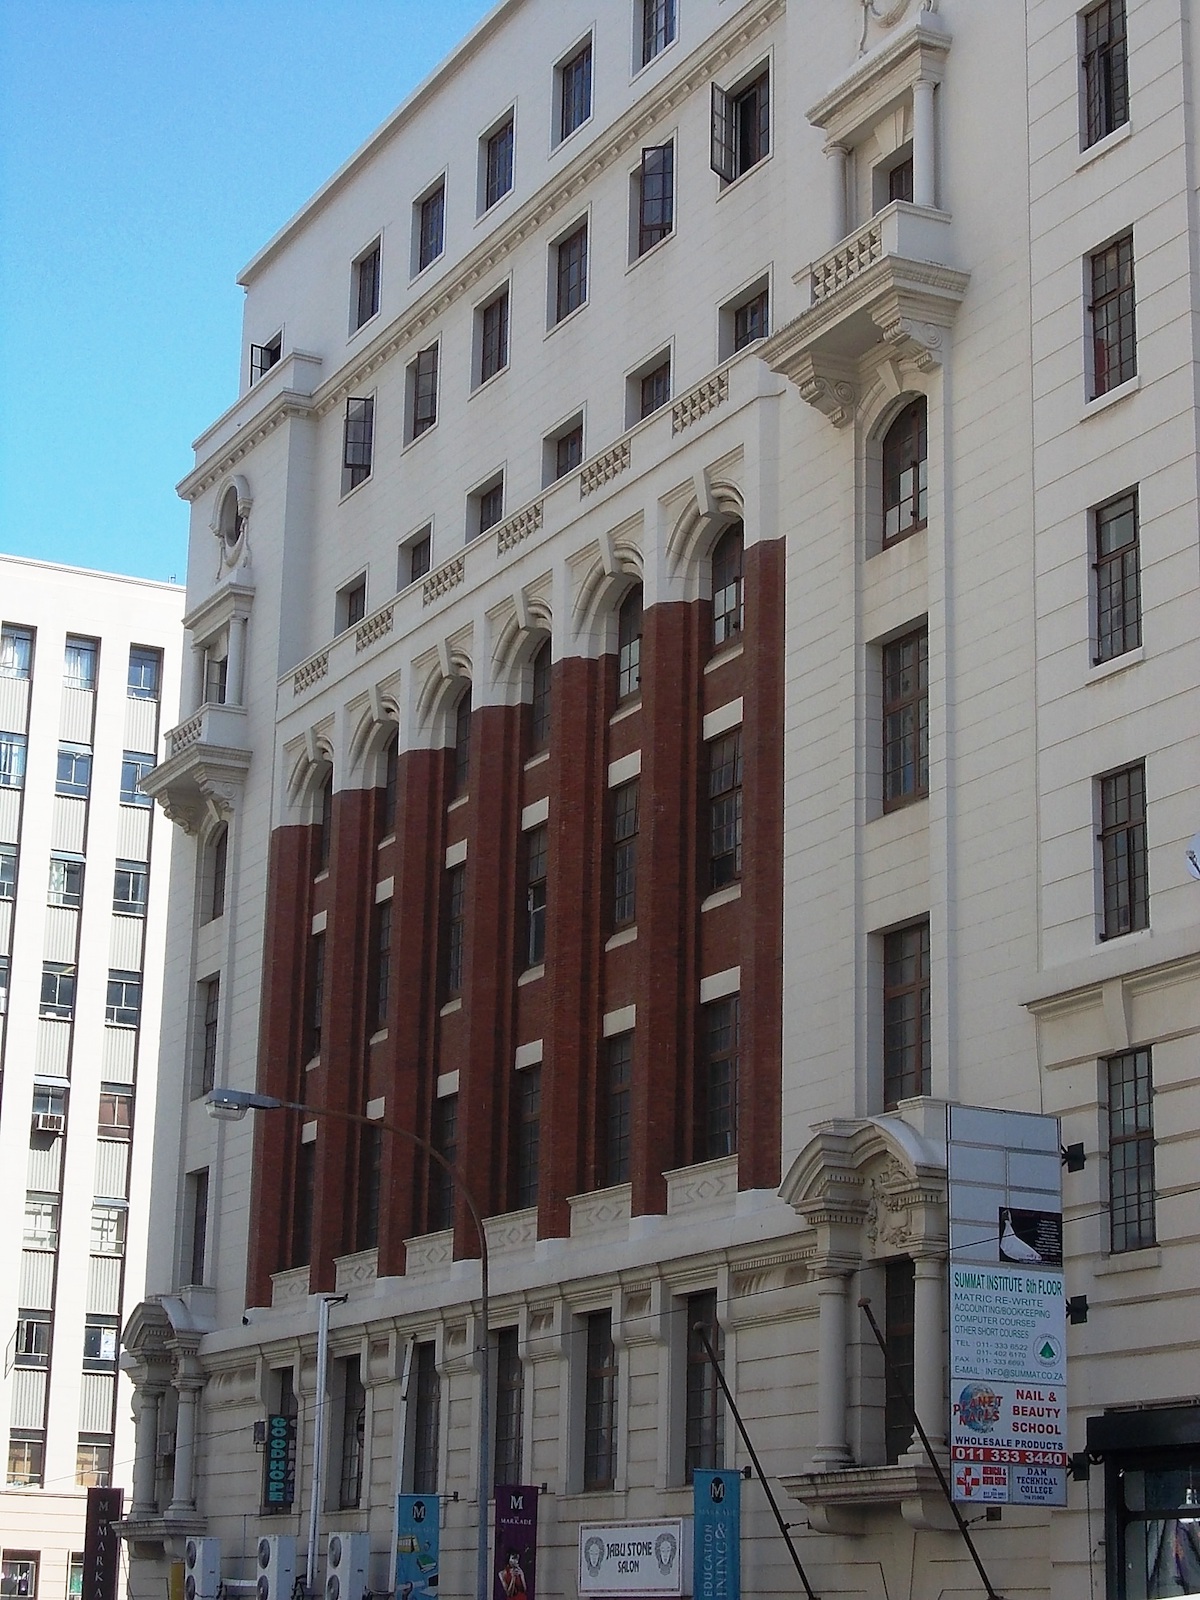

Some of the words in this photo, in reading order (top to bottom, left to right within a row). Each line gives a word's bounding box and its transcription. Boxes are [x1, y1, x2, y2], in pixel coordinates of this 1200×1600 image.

[955, 1272, 985, 1289] SUMMAT
[987, 1275, 1022, 1293] INSTITUTE
[1026, 1279, 1037, 1294] 6th
[1038, 1279, 1062, 1296] FLOOR
[954, 1293, 992, 1303] MATRIC
[995, 1296, 1043, 1307] RE-WRITE
[954, 1314, 998, 1325] COMPUTER
[999, 1318, 1036, 1328] COURSES
[954, 1325, 976, 1335] OTHER
[978, 1327, 998, 1337] SHORT
[999, 1328, 1029, 1339] COURSES
[1016, 1389, 1044, 1402] NAIL
[1048, 1391, 1057, 1402] &
[953, 1395, 1003, 1416] PLANET
[1012, 1405, 1061, 1418] BEAUTY
[1012, 1422, 1061, 1435] SCHOOL
[955, 1436, 1012, 1447] WHOLESALE
[1015, 1439, 1063, 1451] PRODUCTS
[955, 1448, 984, 1460] 011
[990, 1449, 1020, 1462] 333
[1025, 1451, 1062, 1464] 3440
[1027, 1468, 1047, 1476] DAM
[1016, 1476, 1058, 1486] TECHNICAL
[711, 1483, 724, 1498] M
[1020, 1485, 1053, 1494] COLLEGE
[510, 1495, 524, 1510] M
[413, 1506, 425, 1518] M
[606, 1543, 626, 1560] JABU
[627, 1541, 652, 1557] STONE
[617, 1560, 640, 1575] SALON
[703, 1524, 713, 1597] EDUCATION
